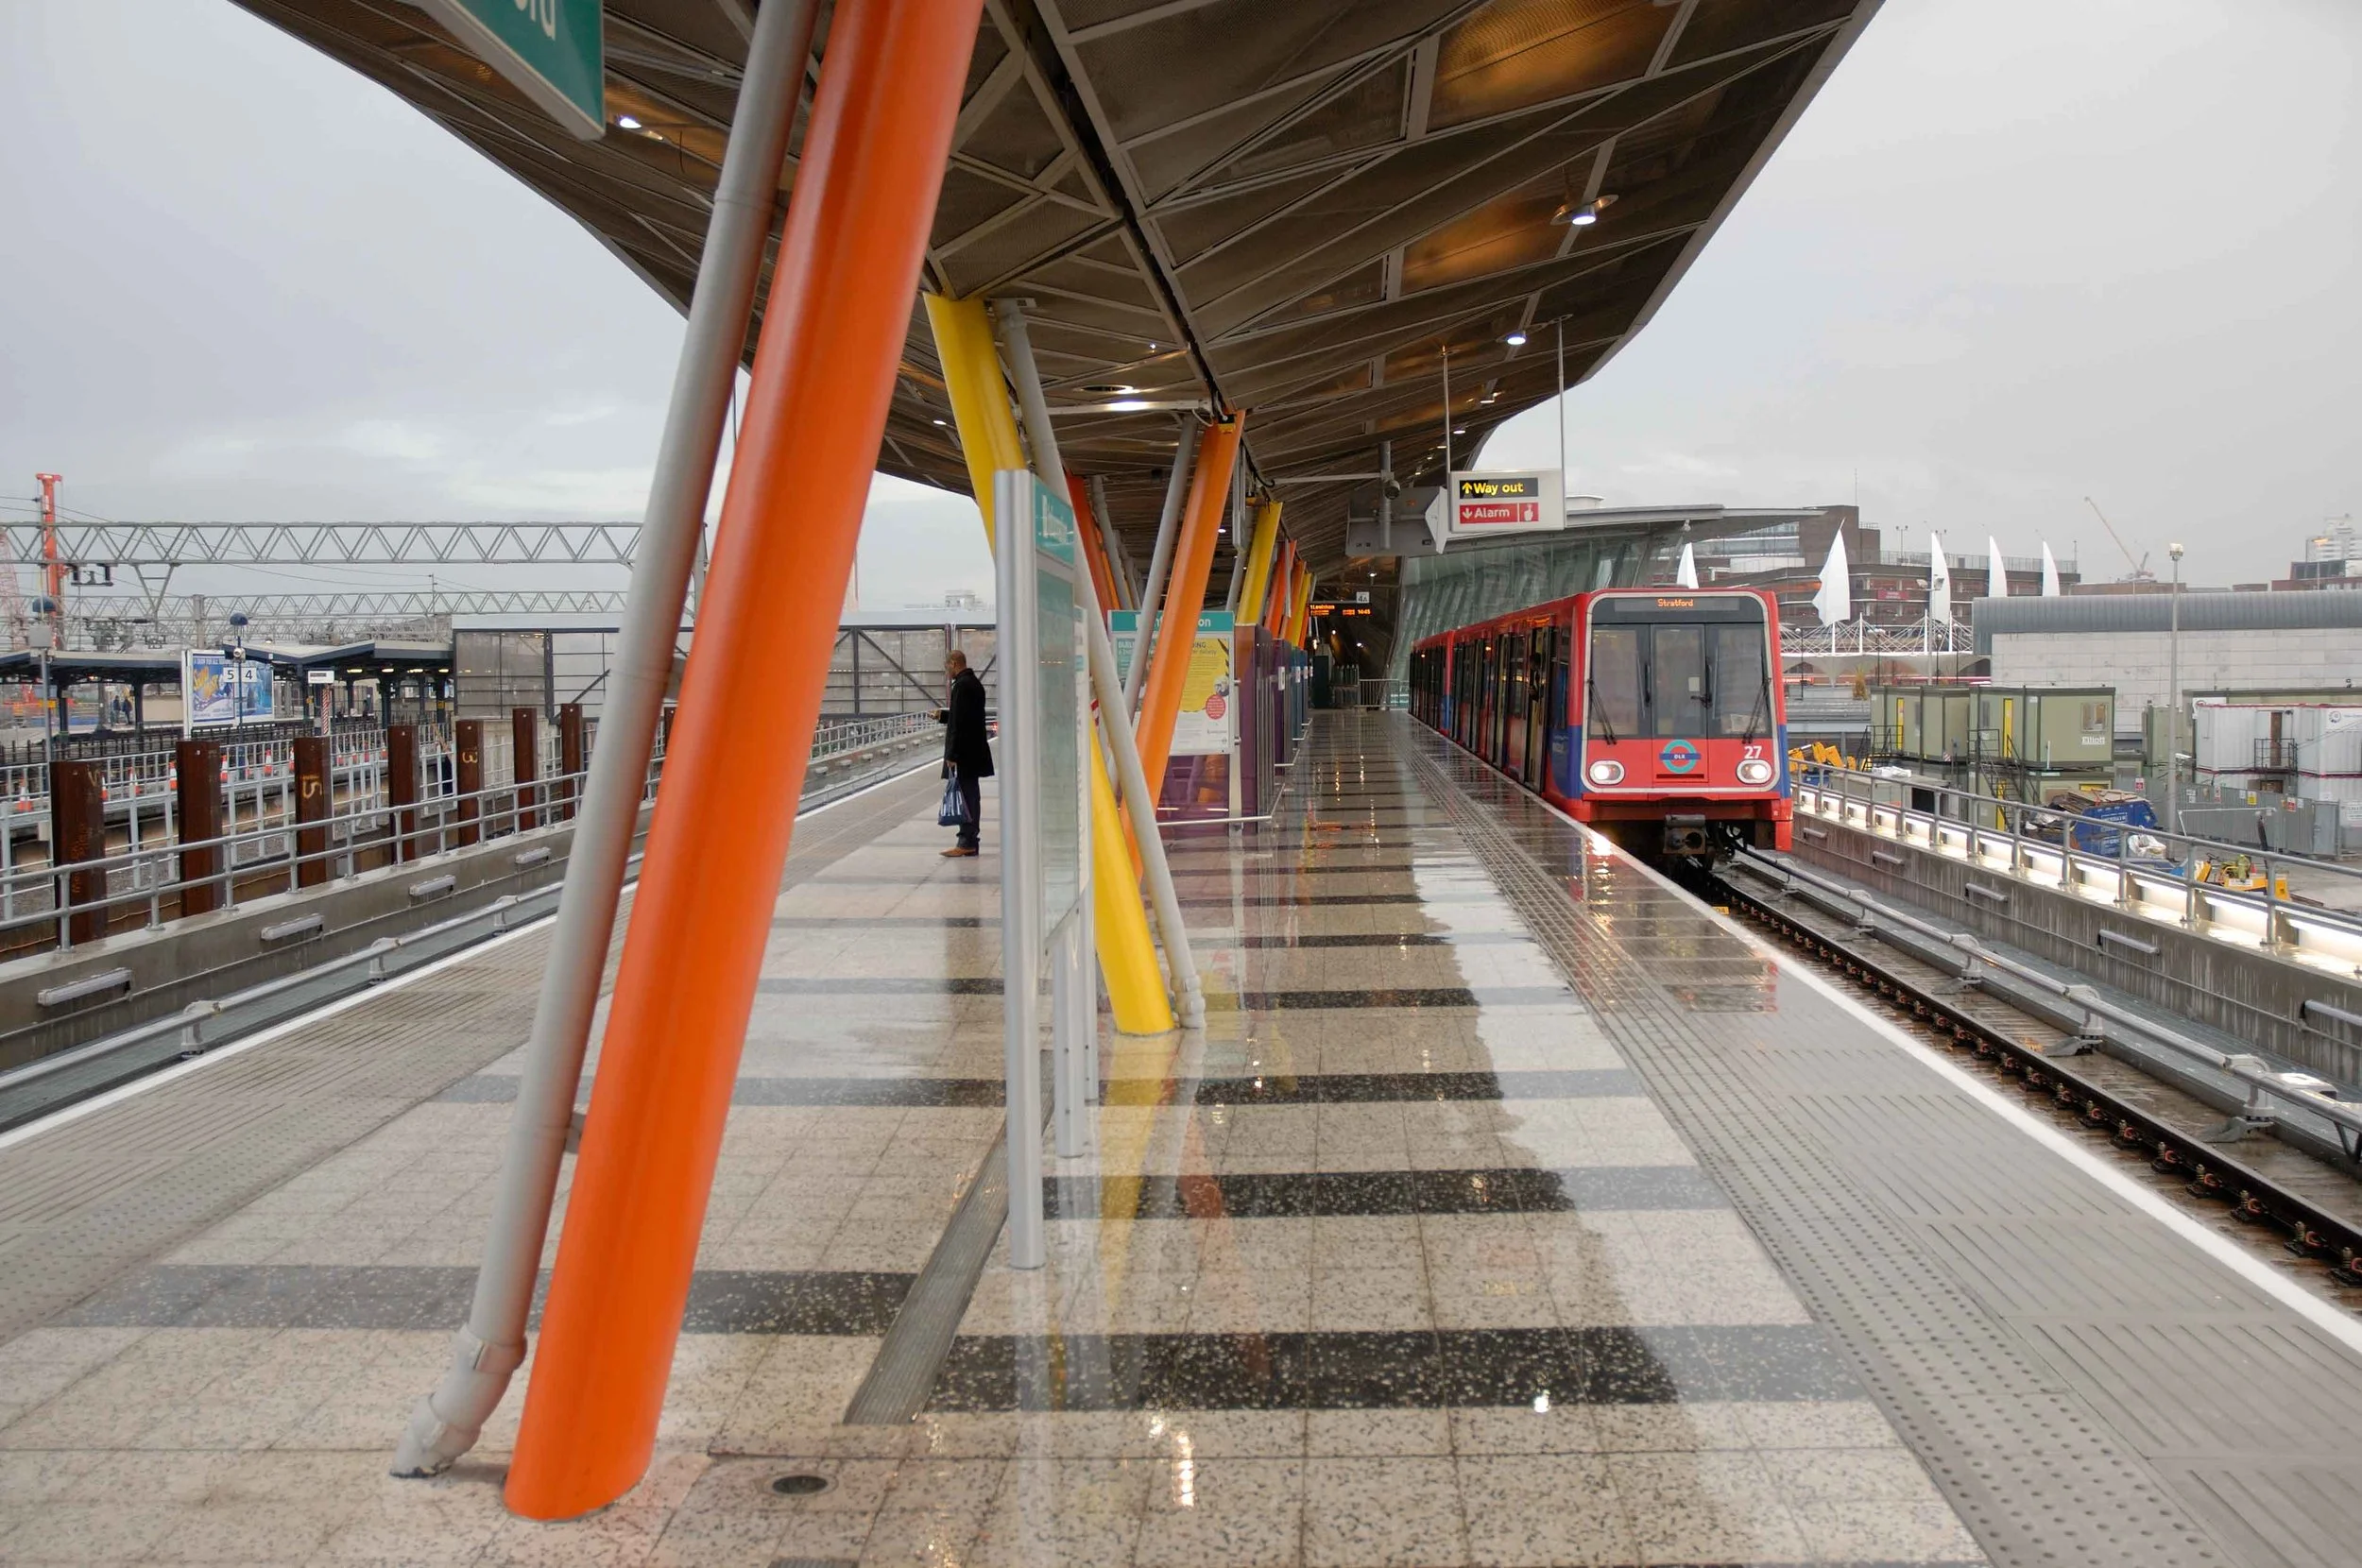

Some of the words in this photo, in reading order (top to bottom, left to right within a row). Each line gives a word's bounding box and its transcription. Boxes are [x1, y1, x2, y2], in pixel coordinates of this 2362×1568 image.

[1473, 483, 1498, 495] Way
[1501, 482, 1524, 493] out
[1474, 507, 1510, 518] Alarm
[1657, 598, 1694, 607] Stratford
[228, 669, 234, 679] 5
[245, 669, 252, 679] 4
[1744, 745, 1763, 759] 27
